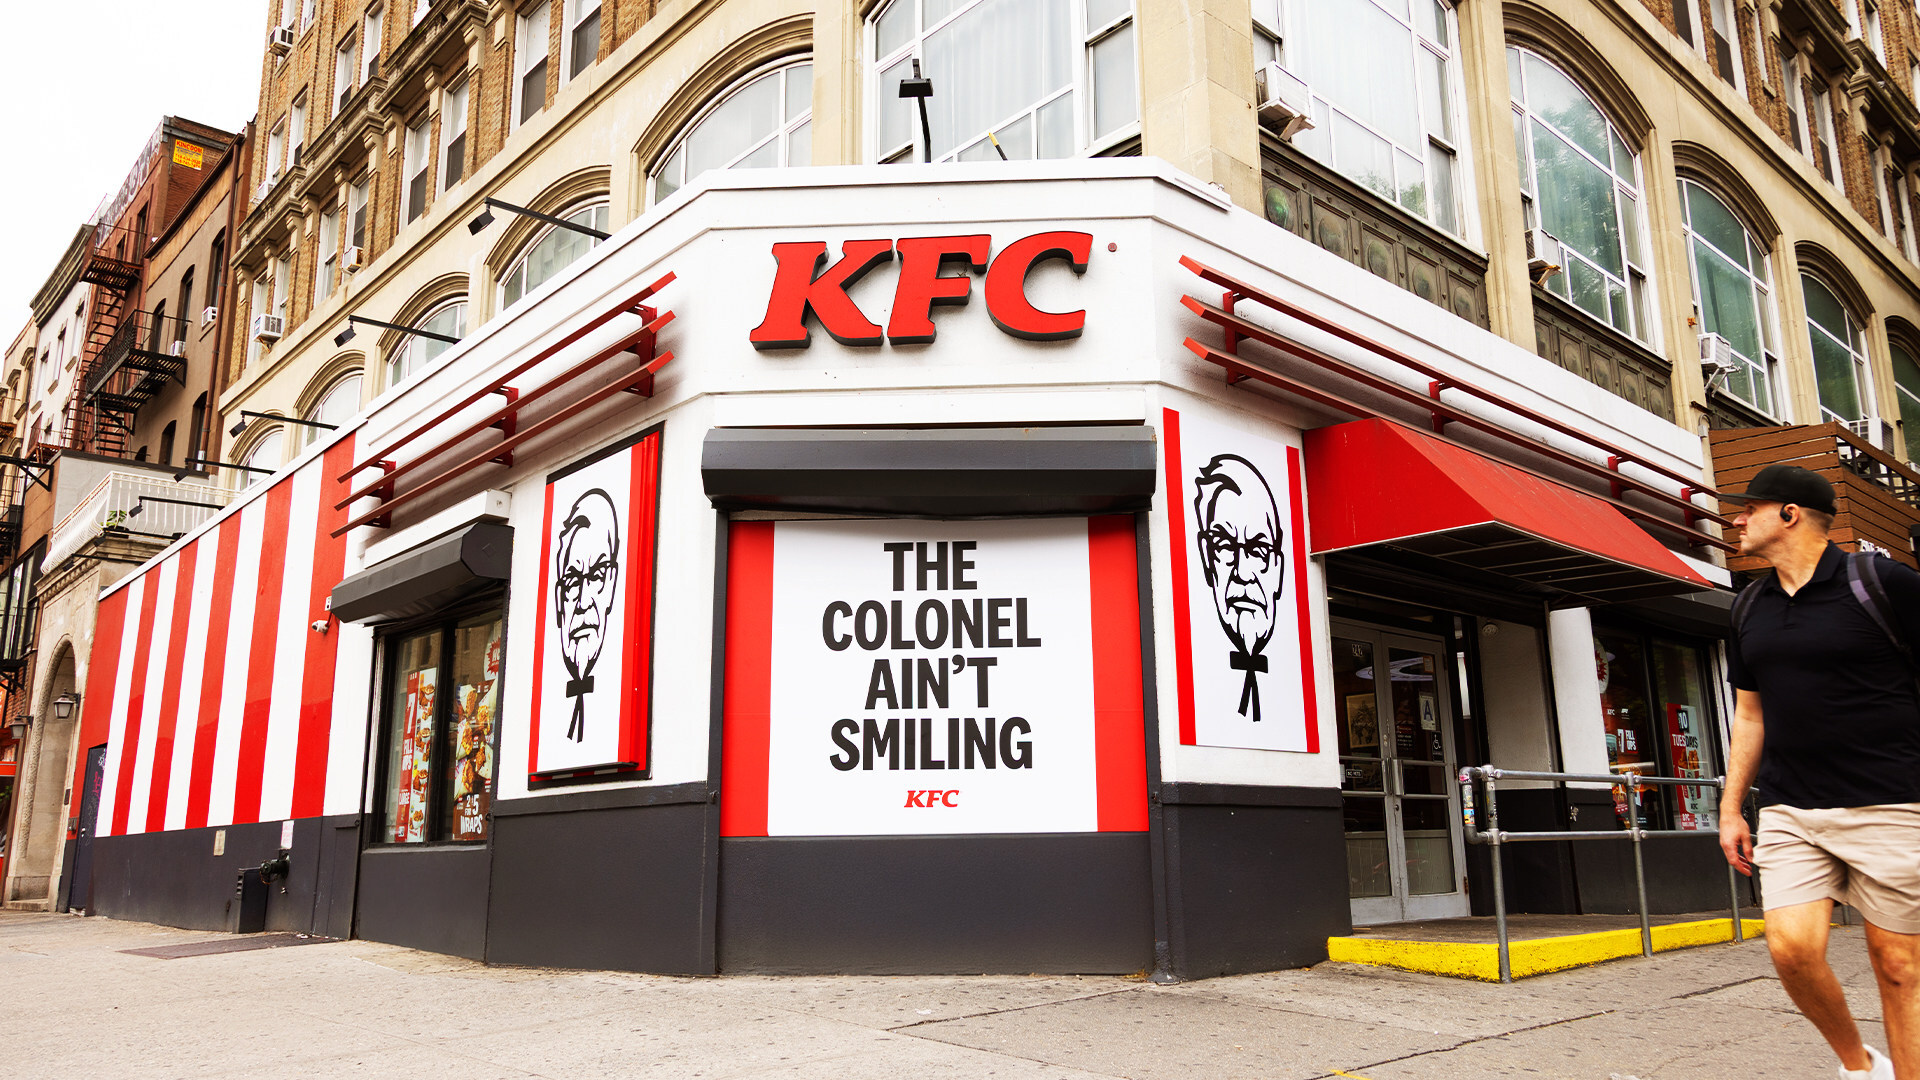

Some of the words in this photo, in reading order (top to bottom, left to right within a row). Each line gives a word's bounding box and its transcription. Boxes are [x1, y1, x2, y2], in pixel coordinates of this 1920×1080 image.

[750, 231, 1093, 350] KFC
[883, 541, 978, 591] THE
[822, 597, 1042, 651] COLONEL
[864, 654, 998, 710] AIN'T
[1423, 700, 1434, 721] A
[829, 716, 1033, 771] SMILING
[1672, 733, 1698, 749] TUESDAYS
[466, 794, 471, 808] 2
[904, 789, 960, 808] KFC
[460, 813, 482, 835] WRAPS
